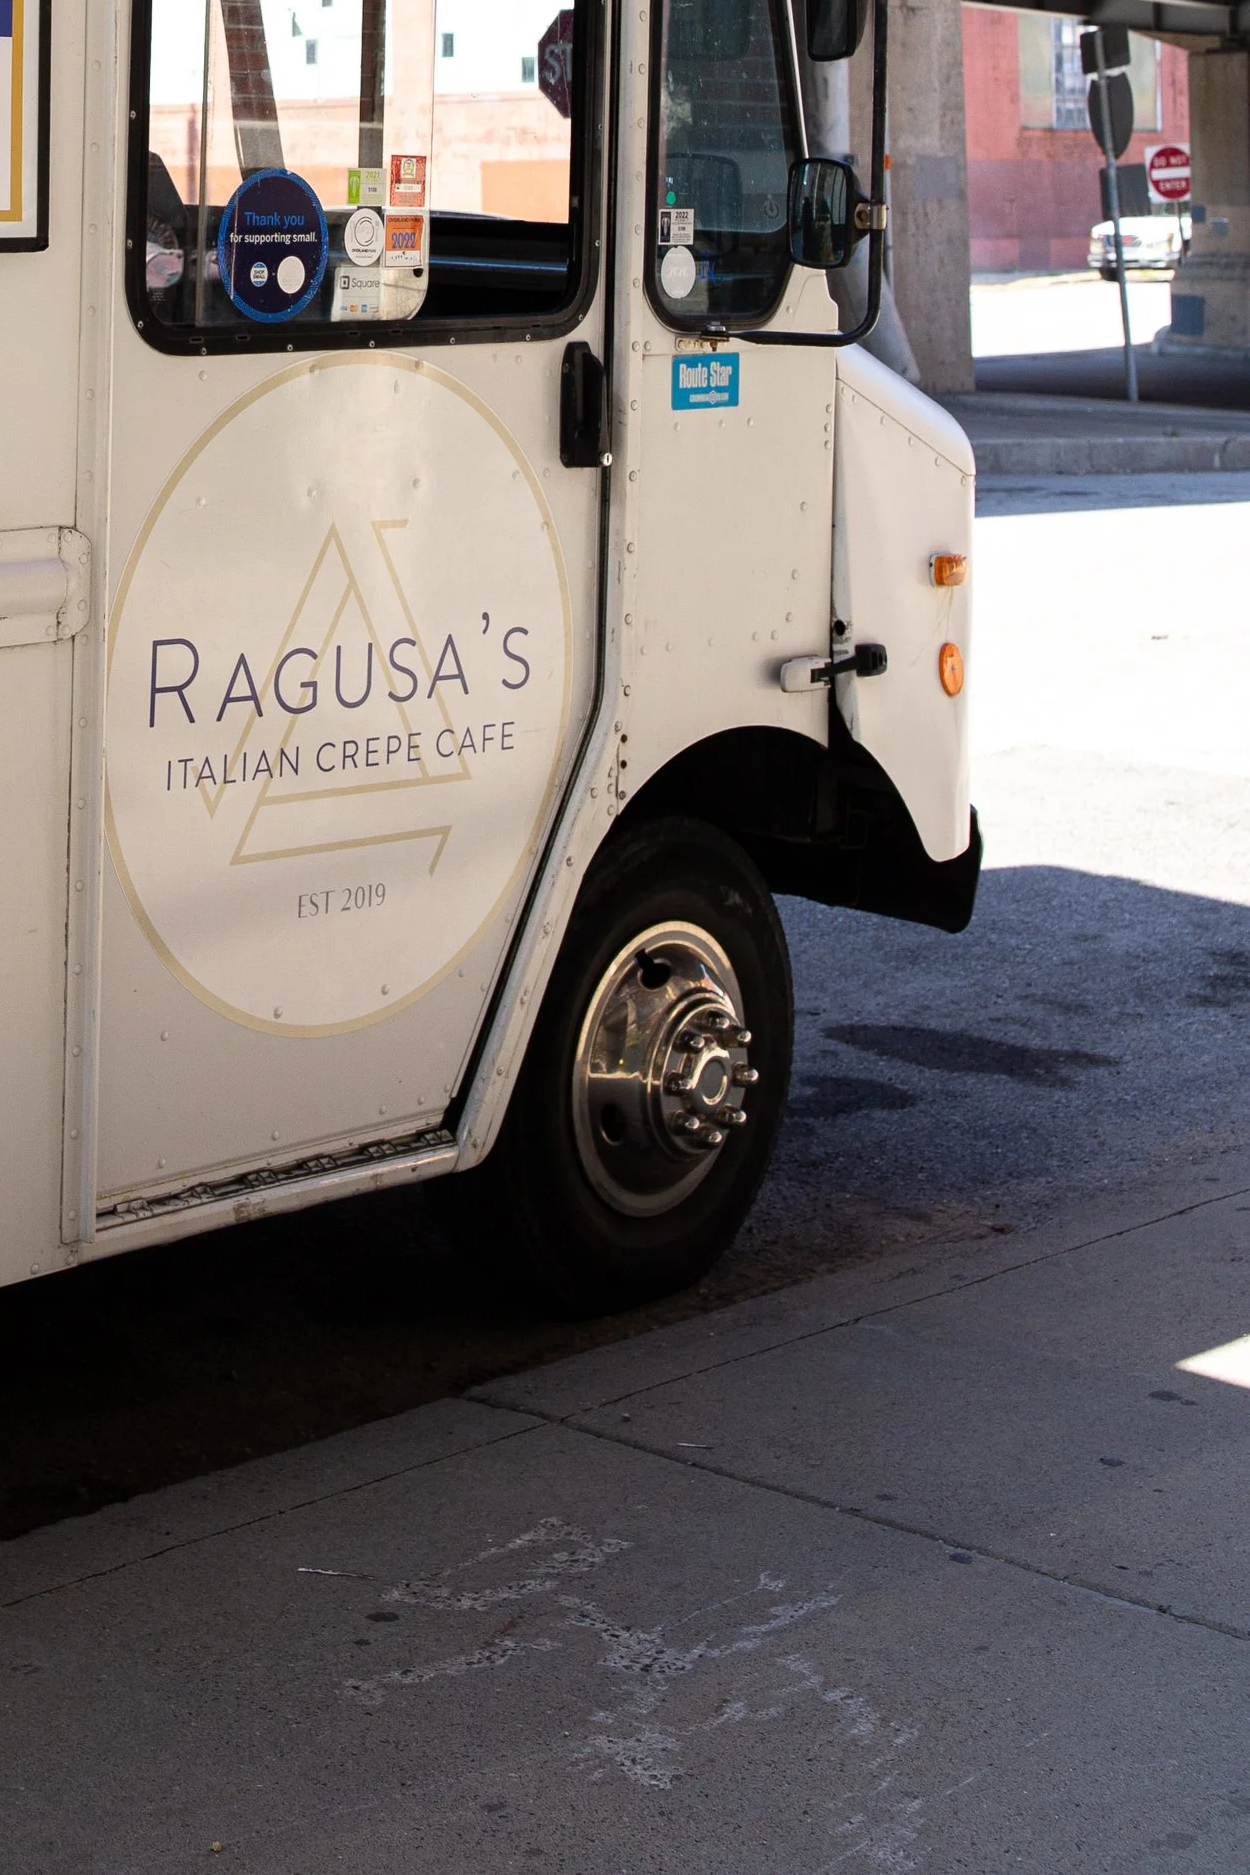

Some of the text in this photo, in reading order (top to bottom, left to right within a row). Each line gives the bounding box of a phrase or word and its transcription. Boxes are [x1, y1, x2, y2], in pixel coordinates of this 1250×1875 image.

[1153, 155, 1187, 167] DO NOT
[1159, 180, 1187, 192] ENTER
[244, 212, 304, 229] Thank you
[675, 211, 689, 219] 2022
[230, 232, 317, 244] for supporting small.
[391, 233, 416, 249] 2022
[352, 278, 380, 290] Square
[679, 362, 732, 389] Route Star
[167, 722, 514, 791] ITALIAN CREPE CAFE
[298, 884, 385, 918] EST 2019
